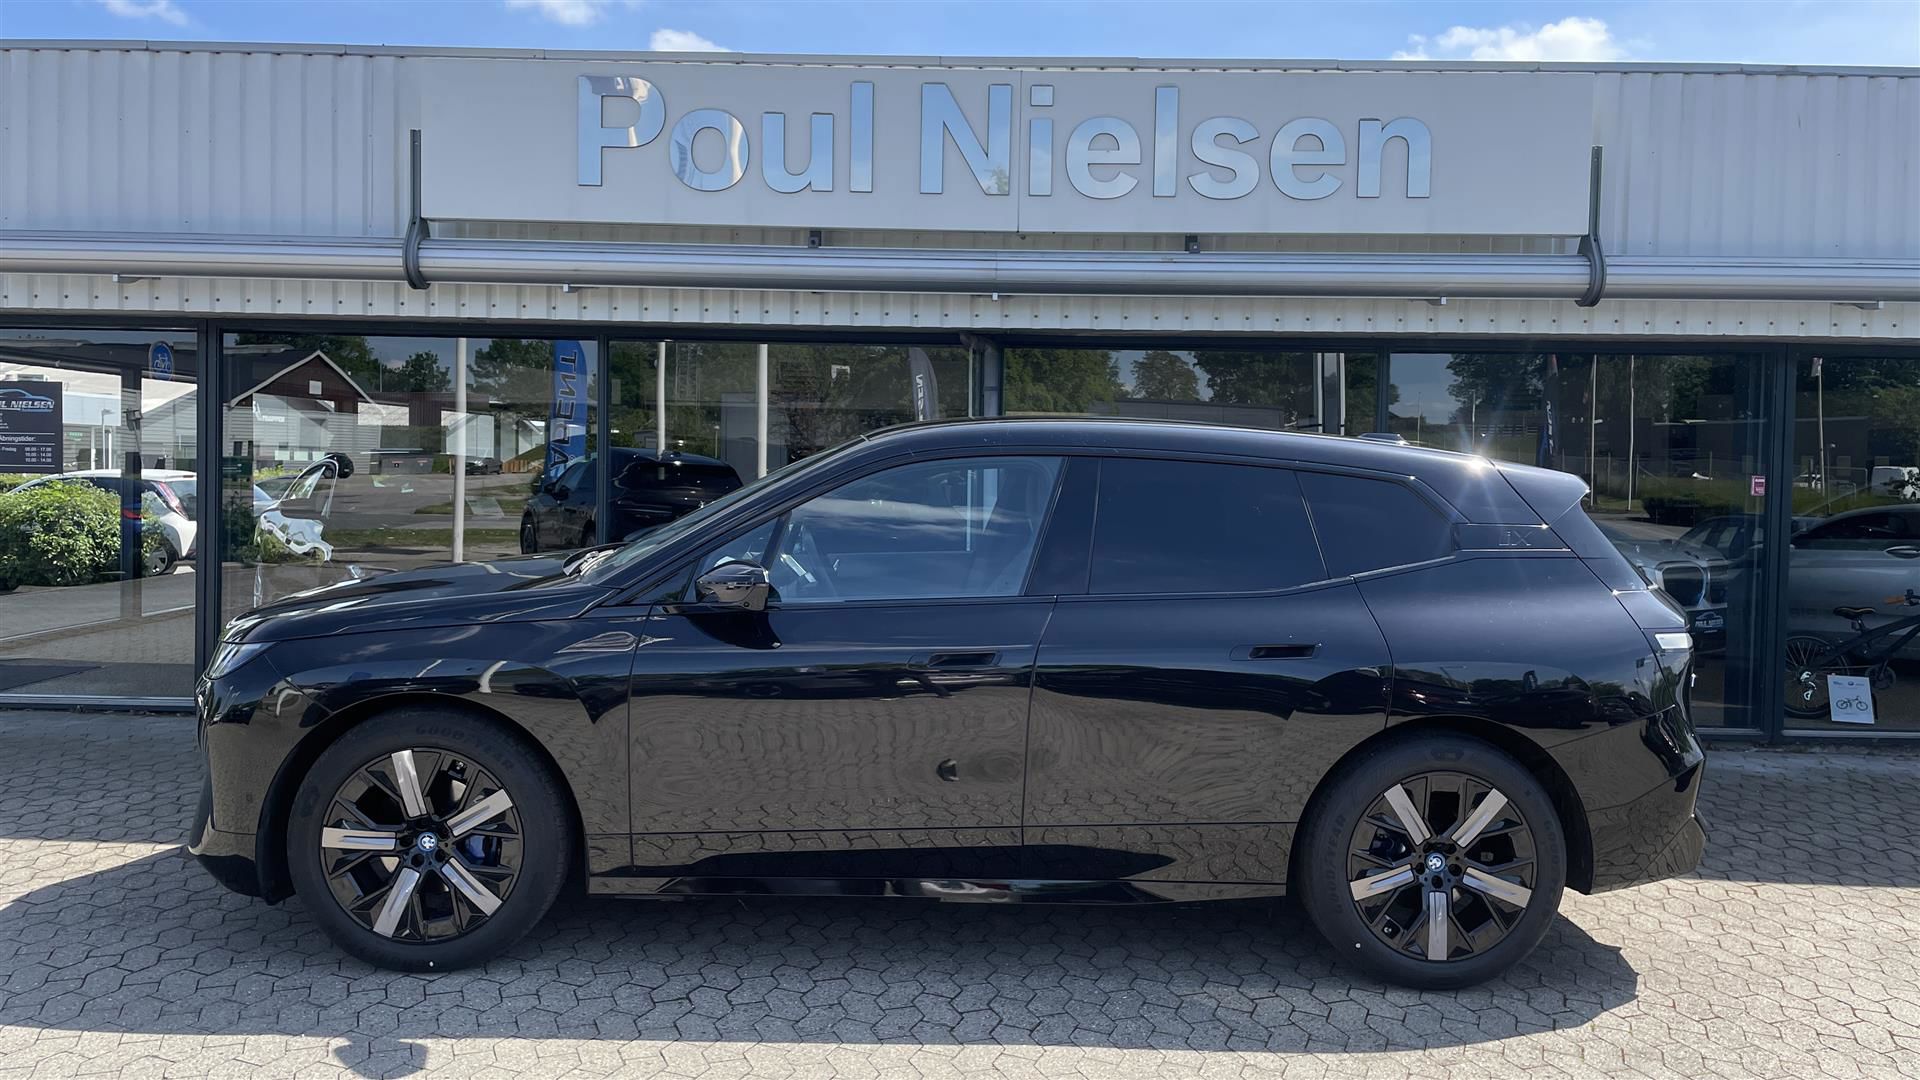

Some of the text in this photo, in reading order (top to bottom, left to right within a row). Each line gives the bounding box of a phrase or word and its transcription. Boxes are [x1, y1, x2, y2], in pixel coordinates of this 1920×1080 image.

[576, 75, 1433, 200] Poul Nielsen
[10, 400, 55, 409] NIELSEN
